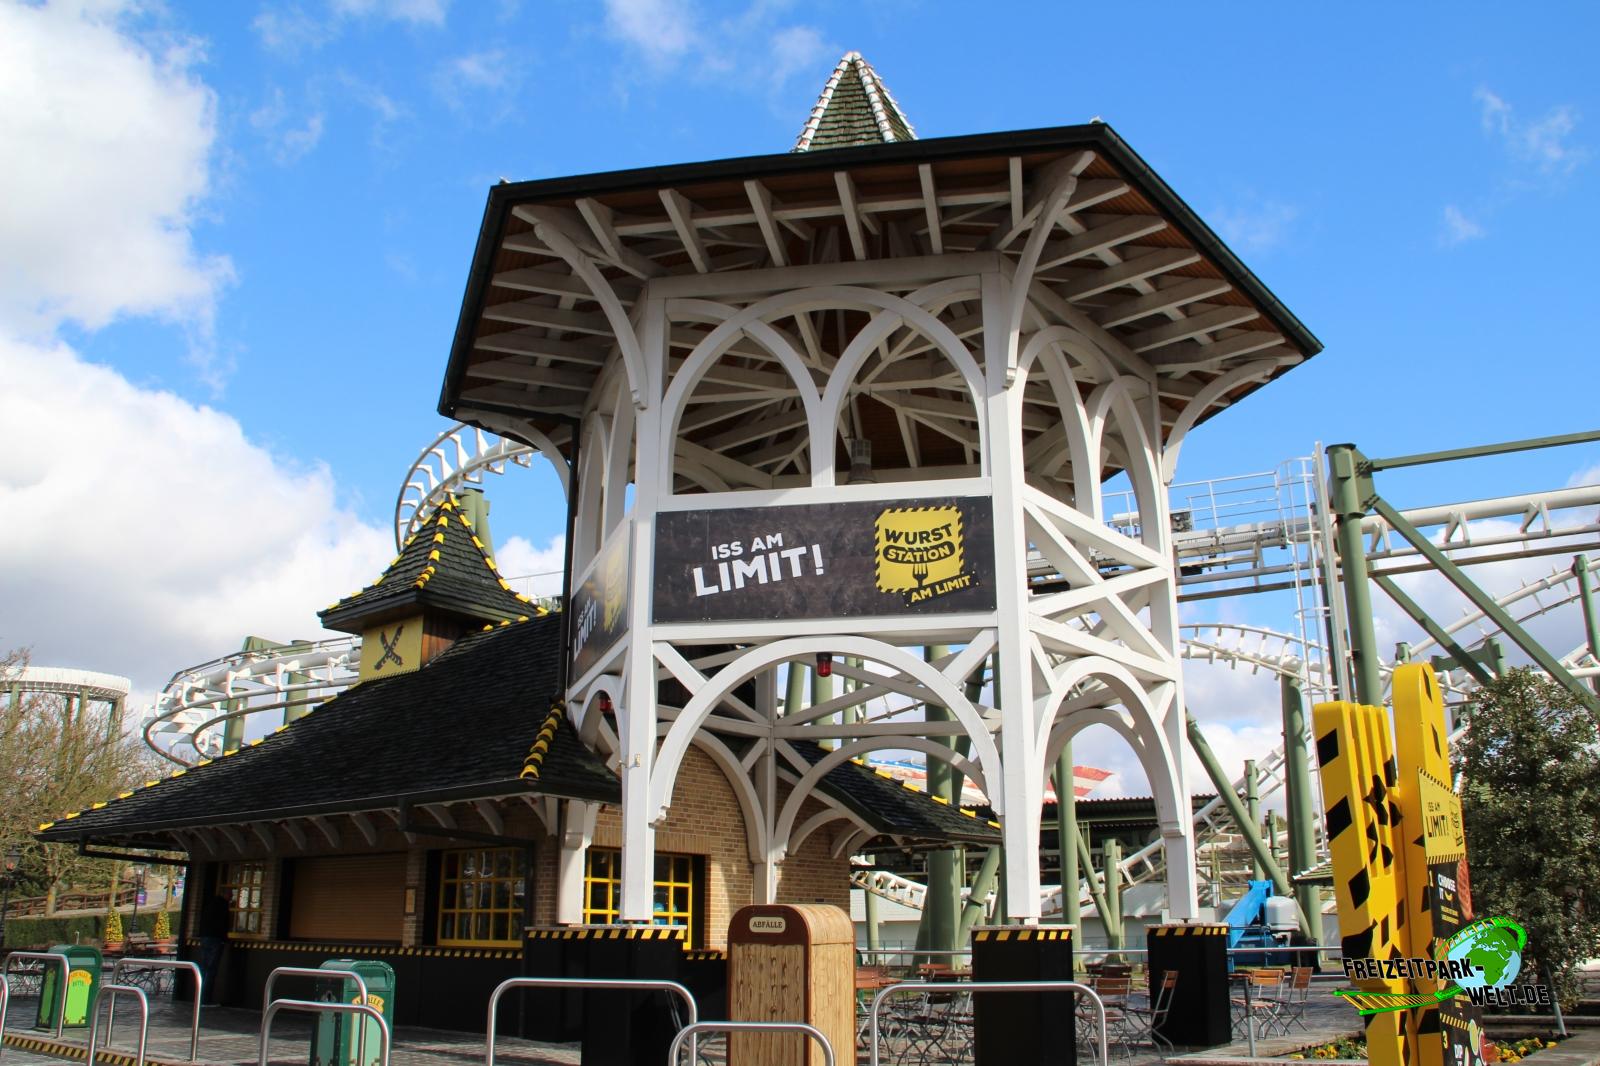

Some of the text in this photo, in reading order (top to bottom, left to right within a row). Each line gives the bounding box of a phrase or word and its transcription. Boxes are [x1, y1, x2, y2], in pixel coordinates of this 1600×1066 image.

[711, 532, 783, 560] ISS AM
[884, 523, 952, 545] WURST
[887, 545, 951, 562] STATION
[693, 543, 824, 597] LIMIT!
[911, 575, 971, 603] AM LIMIT
